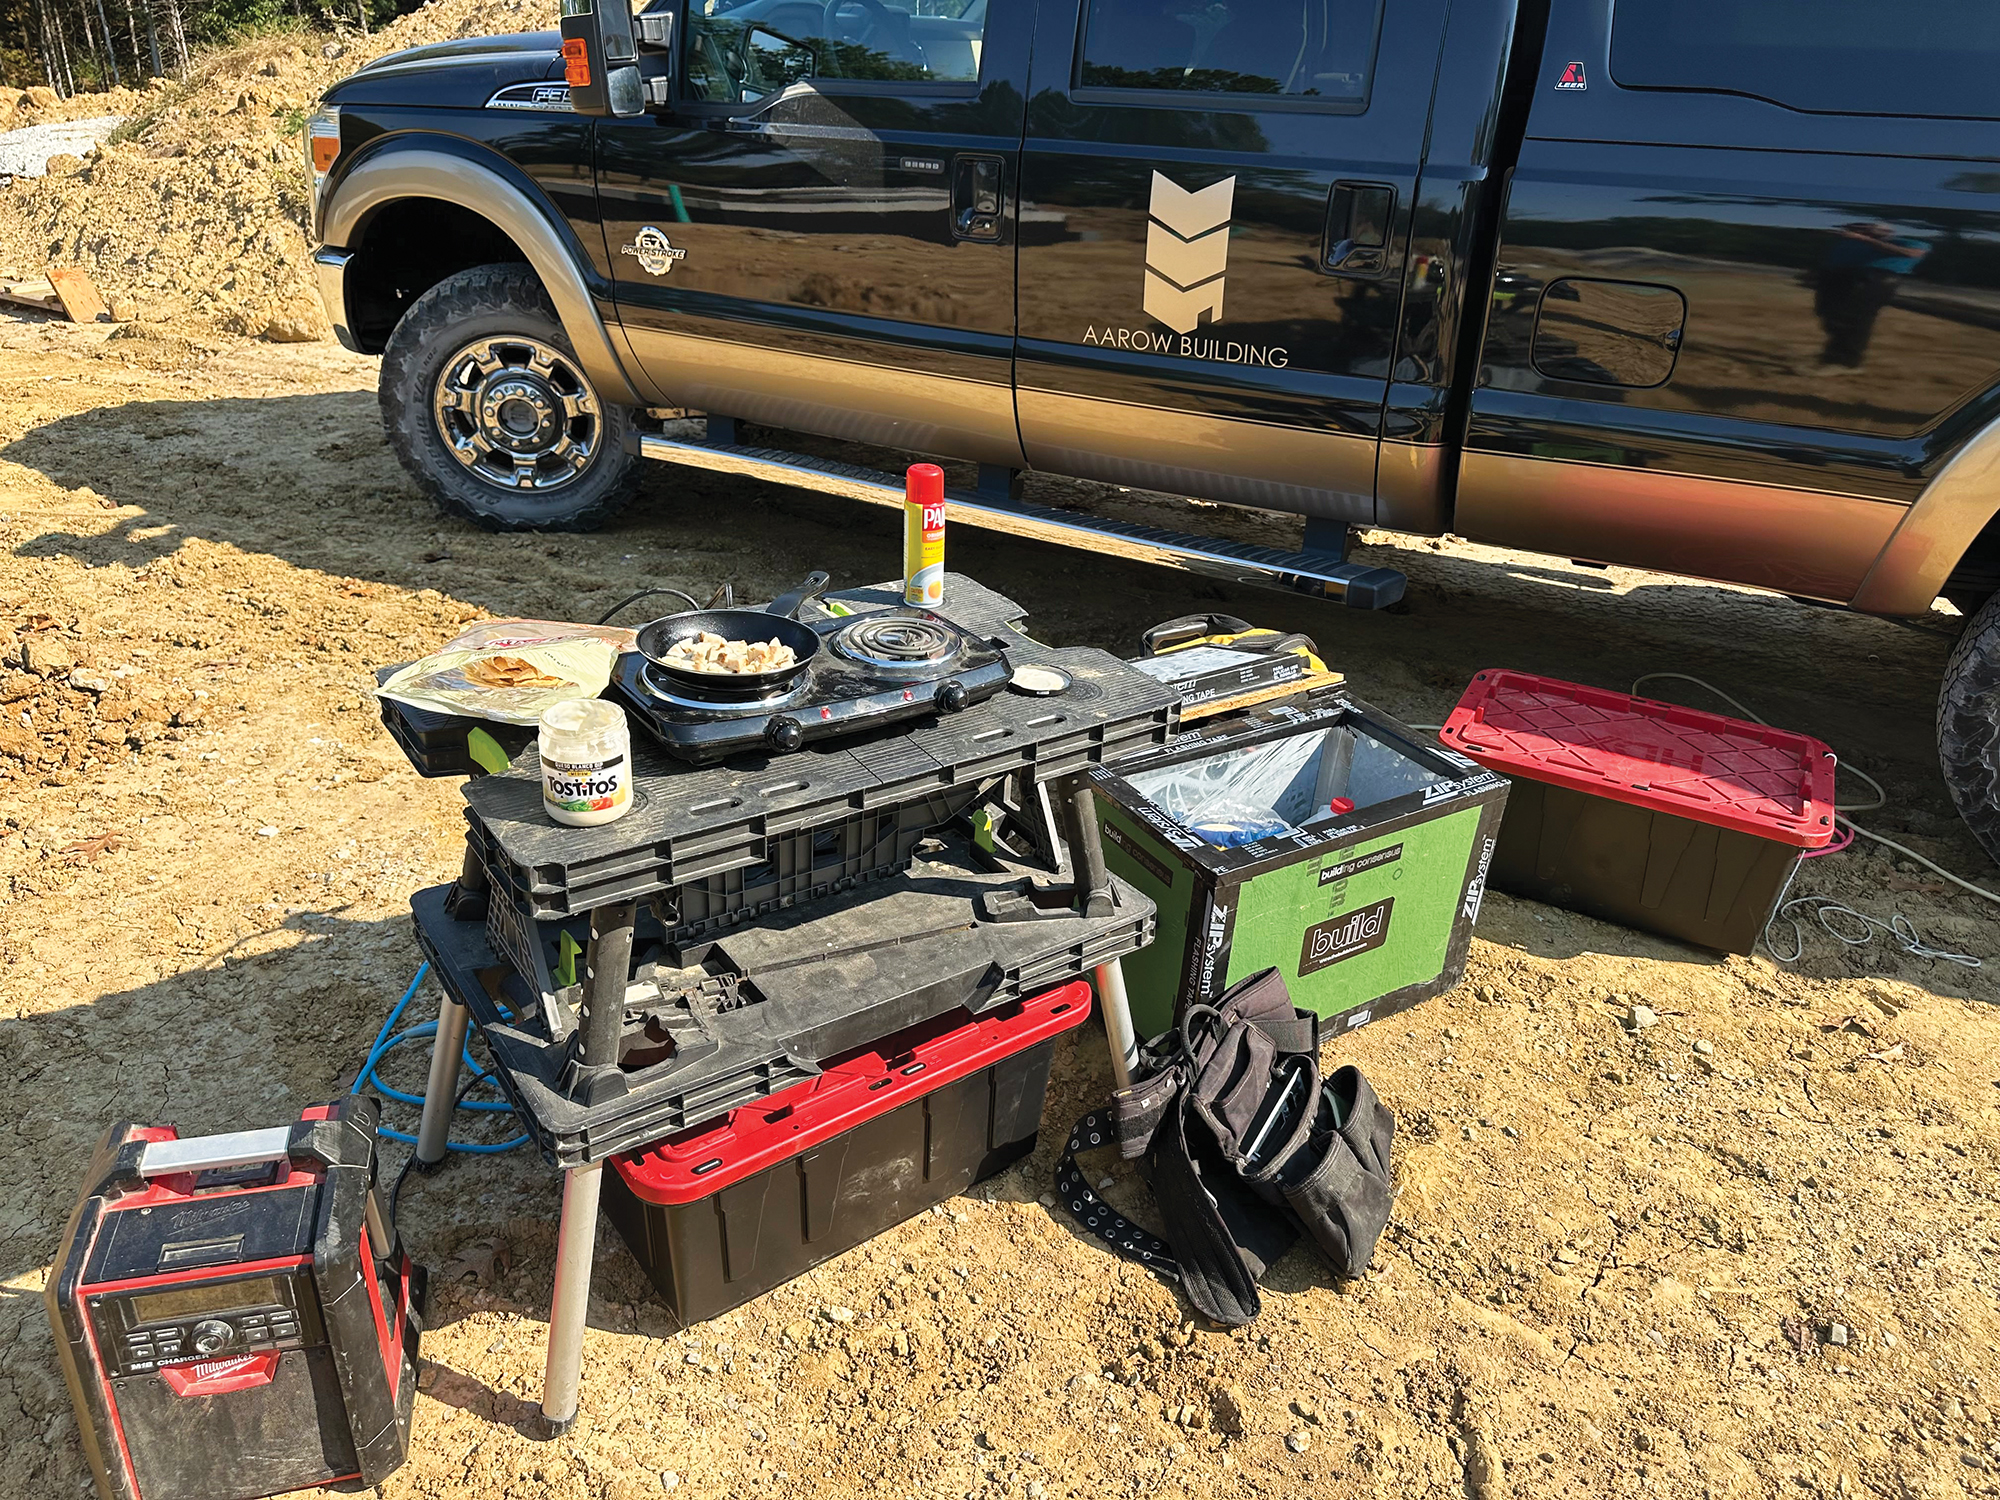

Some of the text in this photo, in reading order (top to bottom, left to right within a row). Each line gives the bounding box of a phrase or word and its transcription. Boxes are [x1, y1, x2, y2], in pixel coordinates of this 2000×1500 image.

[622, 245, 686, 259] POWER STROKE
[1082, 324, 1289, 369] AAROW BUILDING
[1195, 688, 1216, 700] TAPE
[547, 775, 618, 797] TOSTITOS
[1321, 861, 1356, 881] building
[1356, 847, 1402, 869] consensus
[1309, 905, 1385, 960] build
[1188, 937, 1202, 987] FLASHING
[156, 1353, 210, 1367] CHARGER
[191, 1353, 255, 1379] Milwaukee
